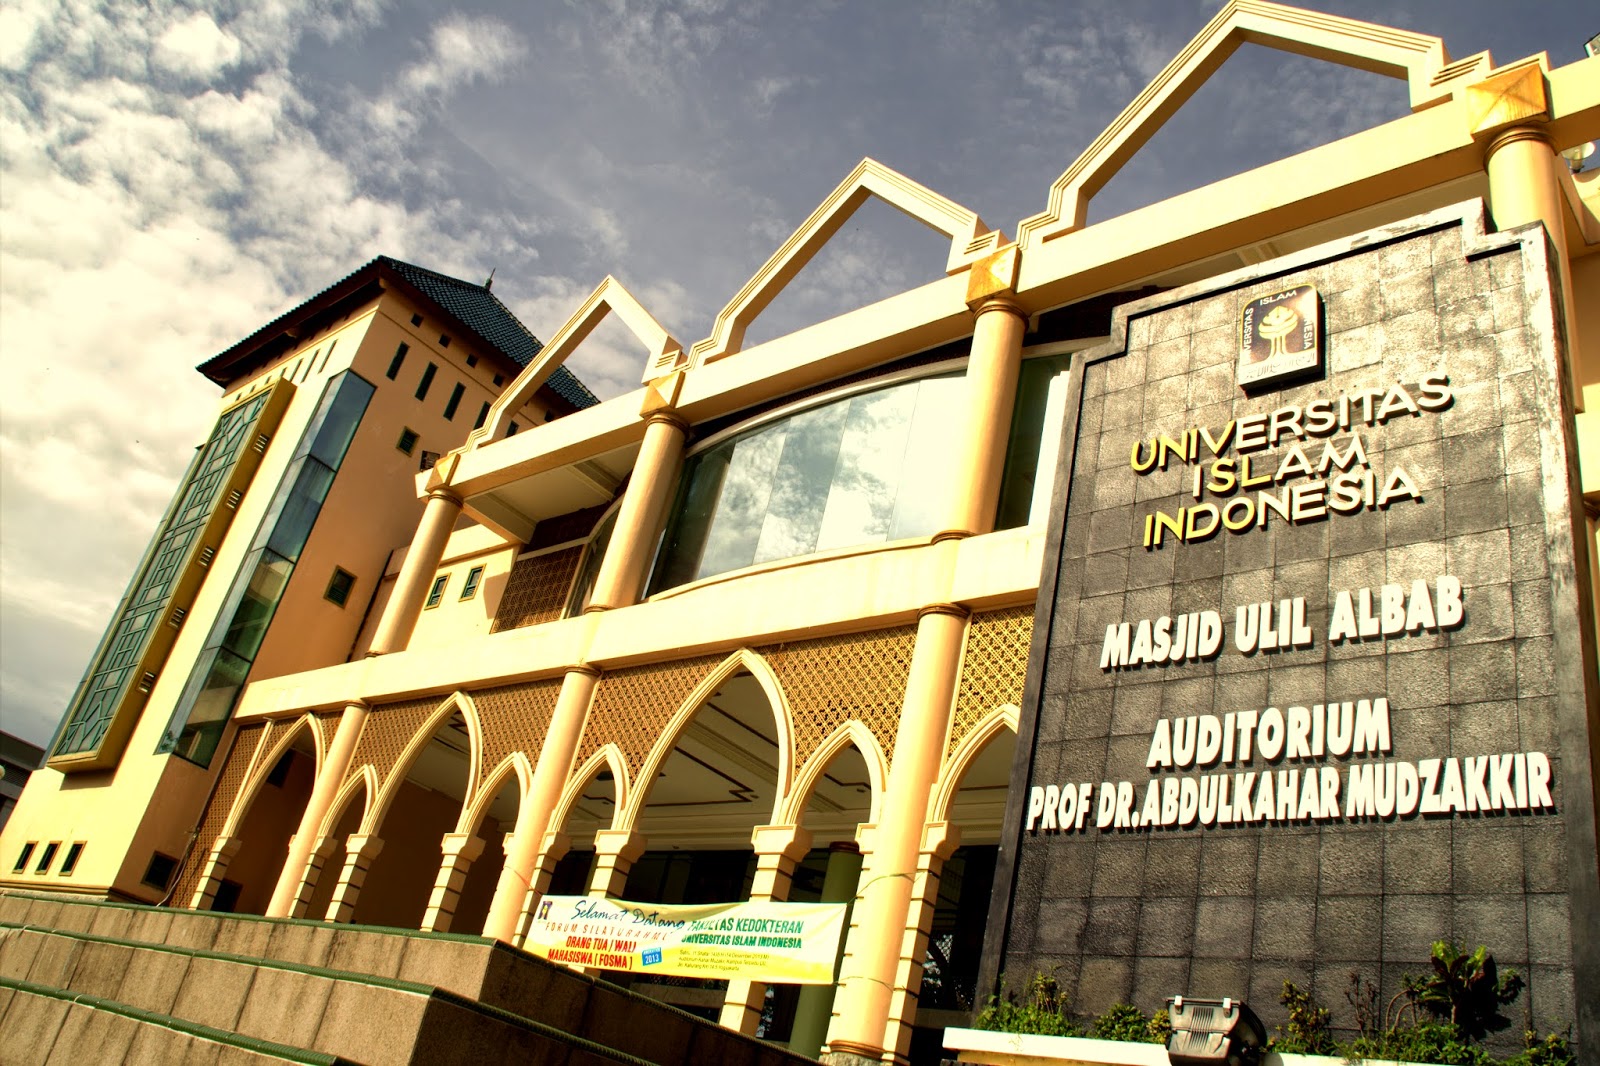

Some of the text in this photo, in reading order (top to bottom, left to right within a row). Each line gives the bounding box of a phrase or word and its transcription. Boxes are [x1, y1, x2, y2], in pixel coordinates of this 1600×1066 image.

[1260, 290, 1297, 306] ISLAM
[1130, 374, 1454, 475] UNIVERSITAS
[1192, 434, 1367, 497] ISLAM
[1143, 466, 1423, 547] INDONESIA
[1100, 575, 1464, 669] MASJID ULIL ALBAB
[1146, 698, 1391, 768] AUDITORIUM
[1027, 783, 1092, 831] PROF
[1346, 752, 1553, 818] MUDZAKKIR
[545, 921, 578, 932] FORUM
[571, 900, 685, 931] Selamat Datang
[687, 918, 804, 934] FAKULTAS KEDOKTERAN
[566, 935, 591, 950] ORANG
[593, 936, 608, 951] TUA
[614, 939, 637, 953] WALI
[681, 933, 802, 949] UNIVERSITAS ISLAM INDONESIA
[547, 949, 593, 965] MAHASISWA
[599, 953, 627, 968] FOSMA
[645, 953, 660, 964] 2013
